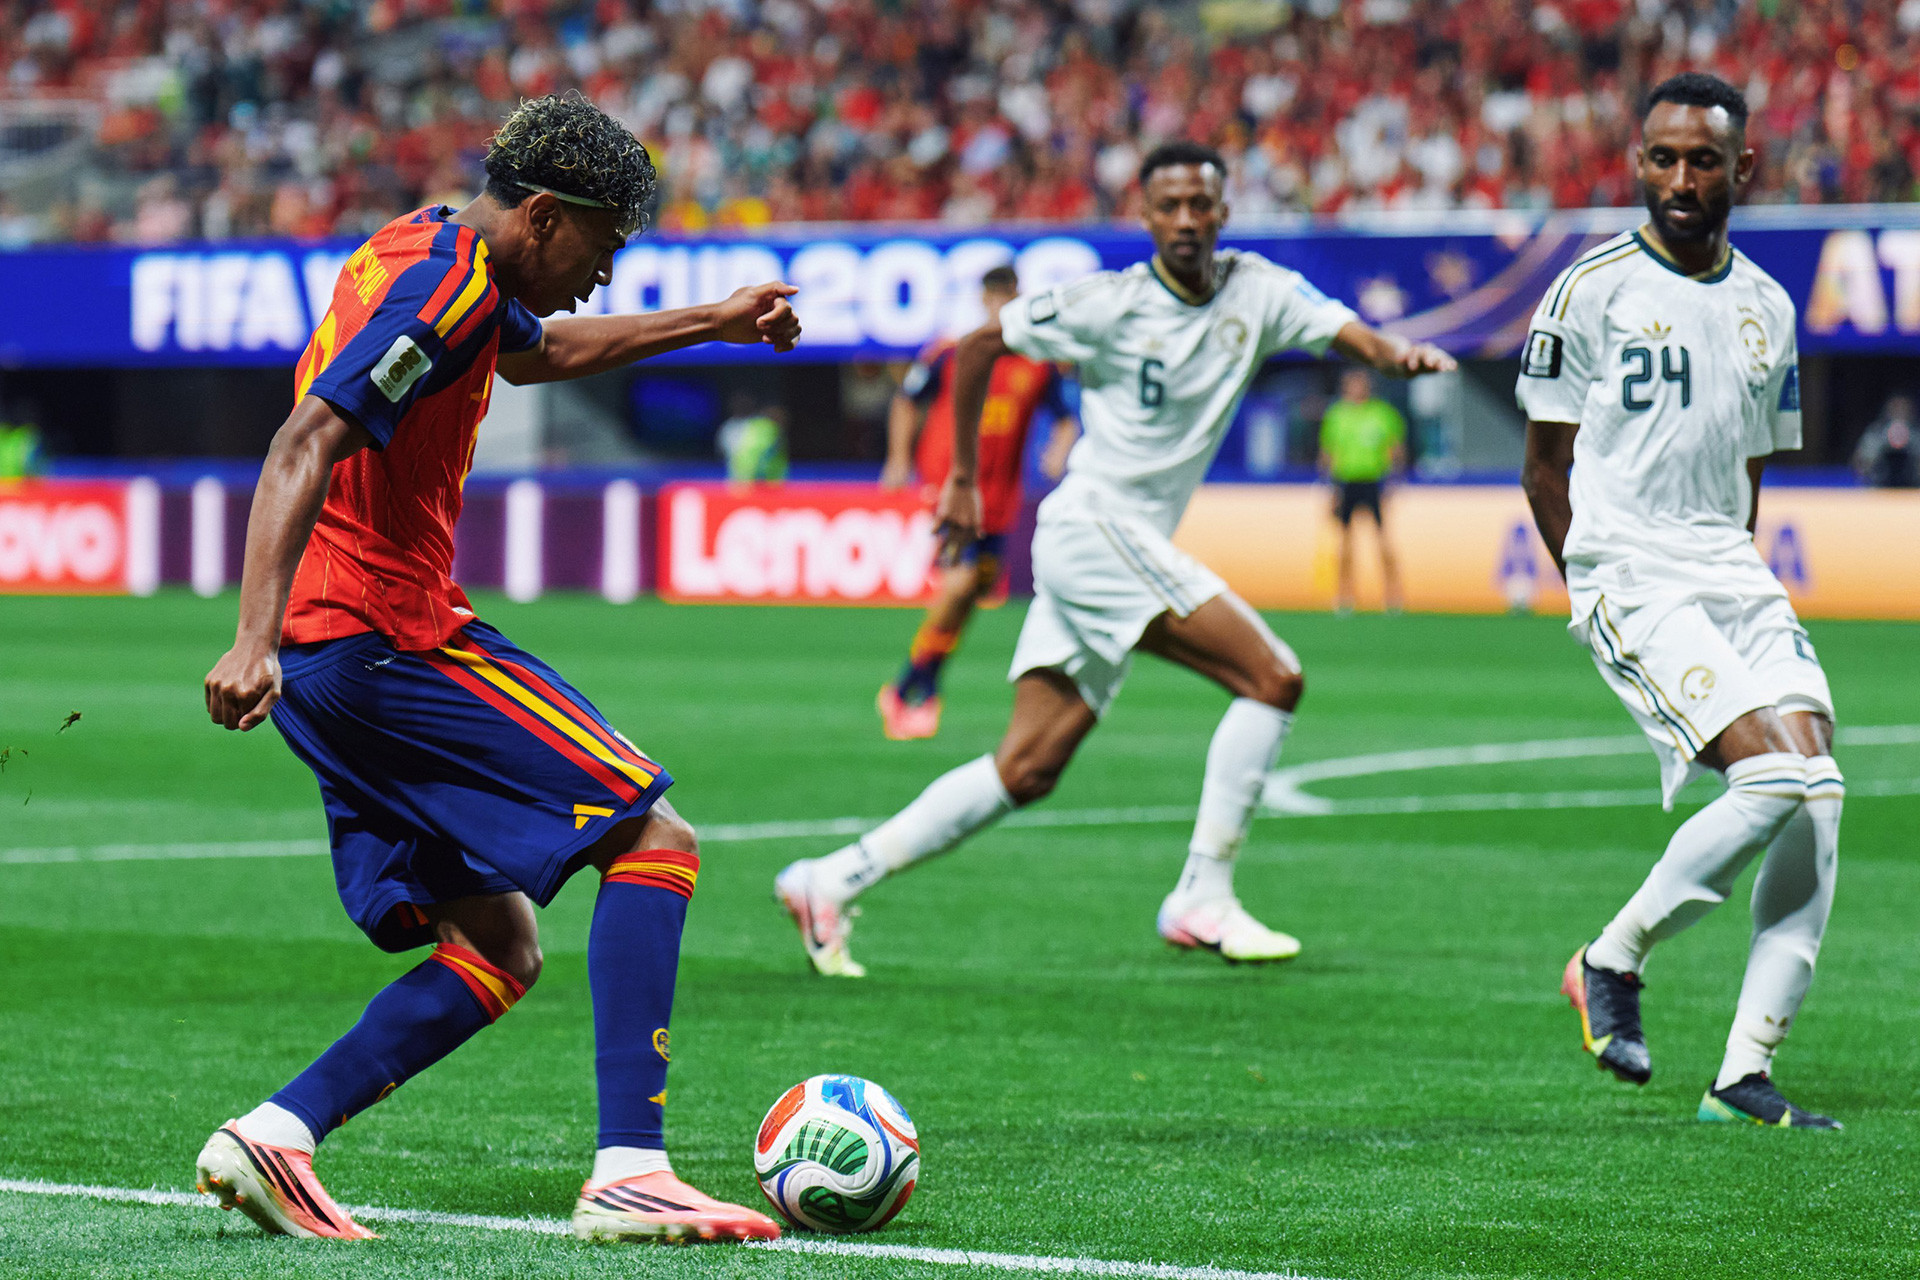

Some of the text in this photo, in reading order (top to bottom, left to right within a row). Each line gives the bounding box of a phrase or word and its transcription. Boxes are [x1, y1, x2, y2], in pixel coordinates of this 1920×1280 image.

[130, 253, 307, 351] FIFA
[1140, 359, 1165, 408] 6
[1621, 345, 1691, 411] 24
[670, 488, 940, 599] Lenov
